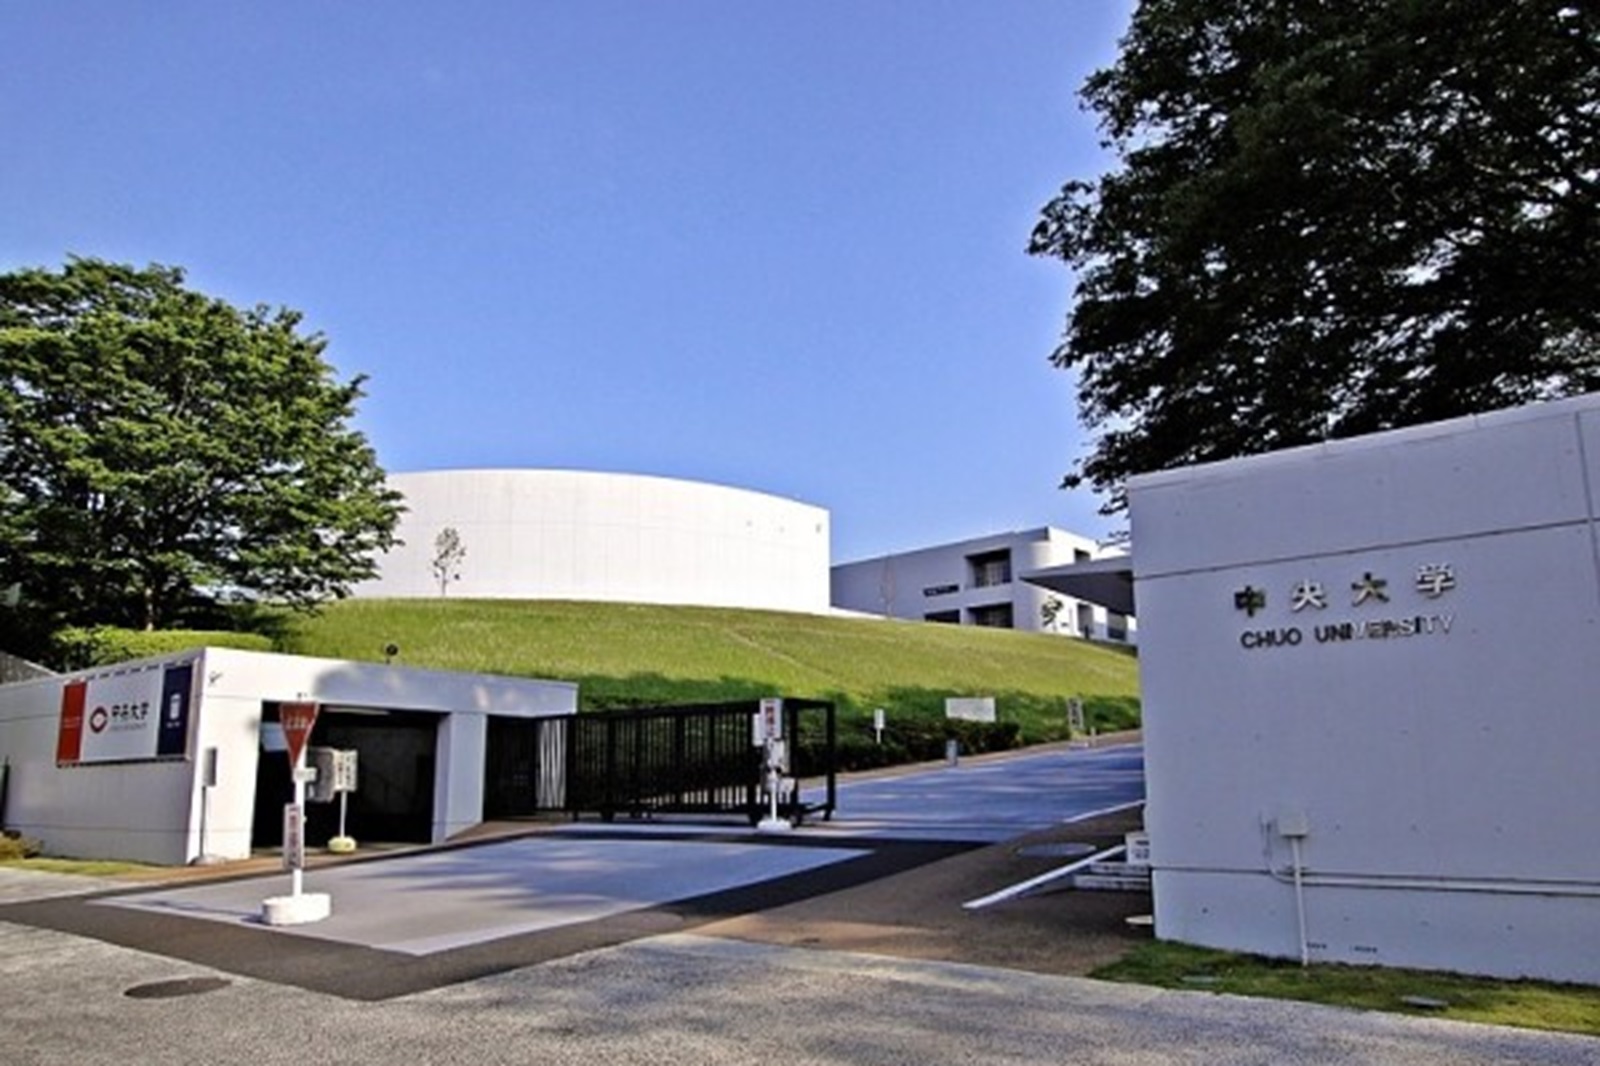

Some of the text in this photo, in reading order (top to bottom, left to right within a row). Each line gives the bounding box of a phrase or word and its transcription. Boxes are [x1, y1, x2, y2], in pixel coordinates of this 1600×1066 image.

[1234, 564, 1456, 617] 中央大学
[1240, 614, 1455, 649] CHUO UNIVERSITY
